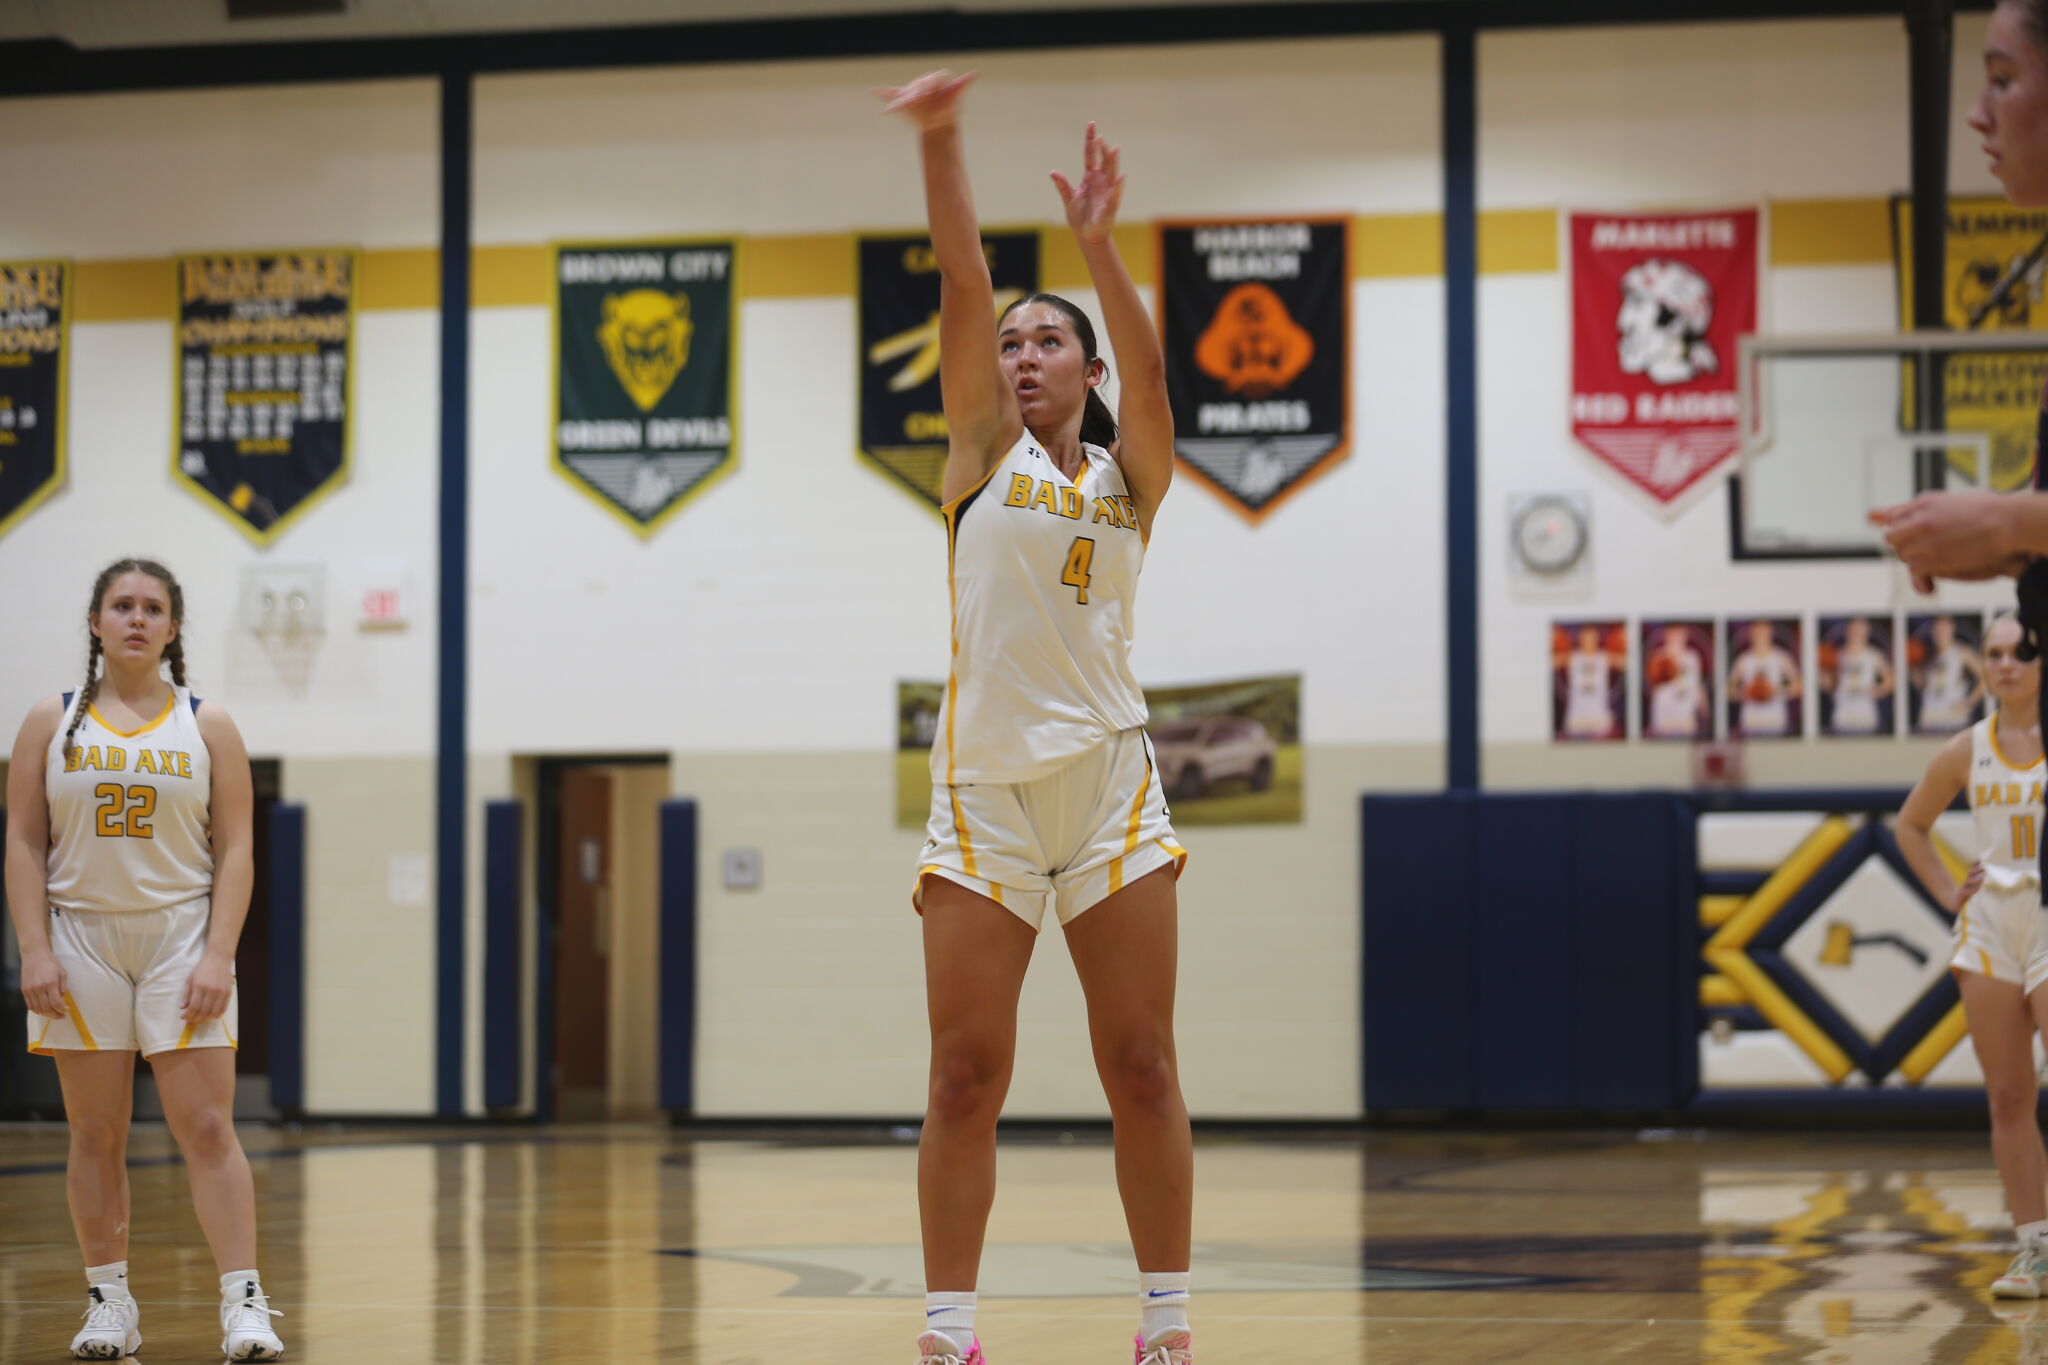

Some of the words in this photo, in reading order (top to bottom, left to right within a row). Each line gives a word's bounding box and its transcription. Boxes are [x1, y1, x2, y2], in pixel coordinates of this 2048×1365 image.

[561, 252, 665, 284] BROWN
[668, 250, 730, 282] CITY
[1198, 400, 1310, 434] PIRATES
[1572, 392, 1630, 424] RED
[1635, 390, 1740, 423] RAIDER
[558, 419, 642, 450] GREEN
[1004, 472, 1084, 521] BAD
[1092, 494, 1138, 531] AXE
[1061, 536, 1096, 606] 4
[63, 745, 127, 774] BAD
[134, 748, 193, 780] AXE
[95, 782, 158, 839] 22
[1974, 783, 2022, 808] BAD
[2010, 814, 2036, 860] 11
